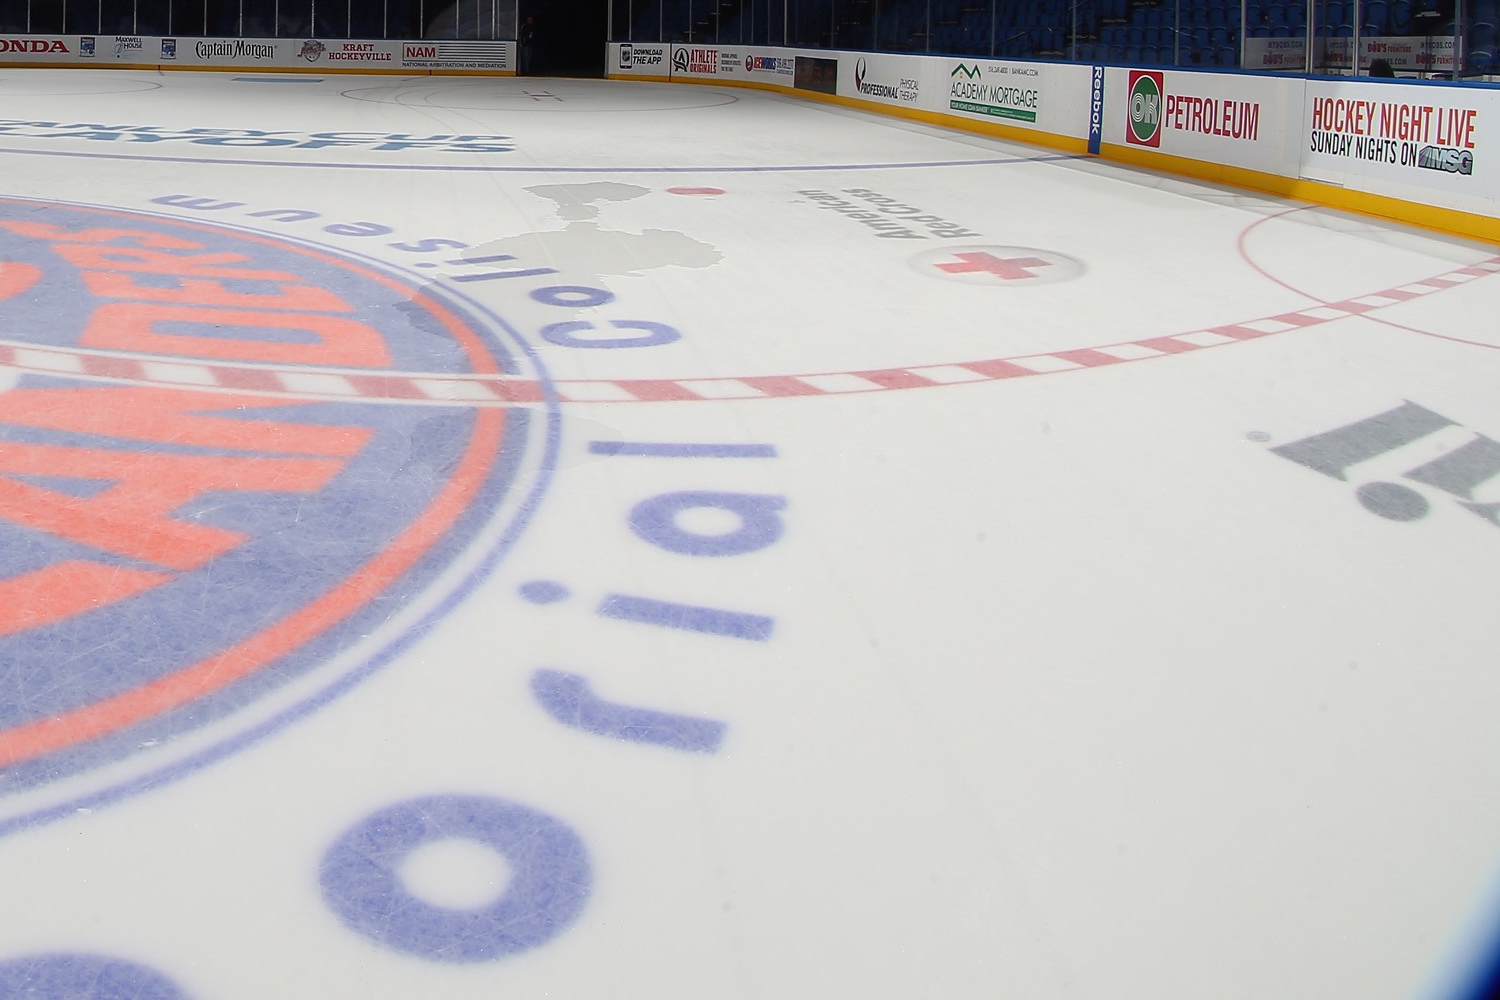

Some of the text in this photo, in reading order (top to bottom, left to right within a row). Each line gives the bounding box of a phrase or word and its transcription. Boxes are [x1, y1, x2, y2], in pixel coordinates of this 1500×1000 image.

[195, 41, 232, 59] Captain
[232, 40, 274, 59] Morgan
[343, 43, 374, 51] KRAFT
[406, 47, 436, 58] NAM
[1367, 41, 1387, 53] BOB'S
[1387, 45, 1412, 53] FURNITURE
[328, 52, 392, 61] HOCKEYVILLE
[633, 56, 662, 64] THE APP
[690, 49, 717, 64] ATHLETE
[1263, 51, 1283, 64] BOB'S
[690, 63, 717, 74] ORIGINALS
[860, 82, 898, 99] PROFESSIONAL
[899, 78, 919, 91] PHYSICAL
[899, 90, 918, 102] THERAPY
[950, 82, 1038, 108] ACADEMY MORTGAGE
[1091, 67, 1102, 135] Reebok
[1132, 93, 1158, 125] OK
[1165, 94, 1259, 141] PETROLEUM
[1312, 97, 1477, 149] HOCKEY NIGHT LIVE
[306, 131, 514, 143] CUP
[1310, 130, 1417, 168] SUNDAY NIGHTS ON
[1429, 145, 1473, 175] MSG
[797, 189, 930, 240] American
[841, 187, 983, 239] Red Cross
